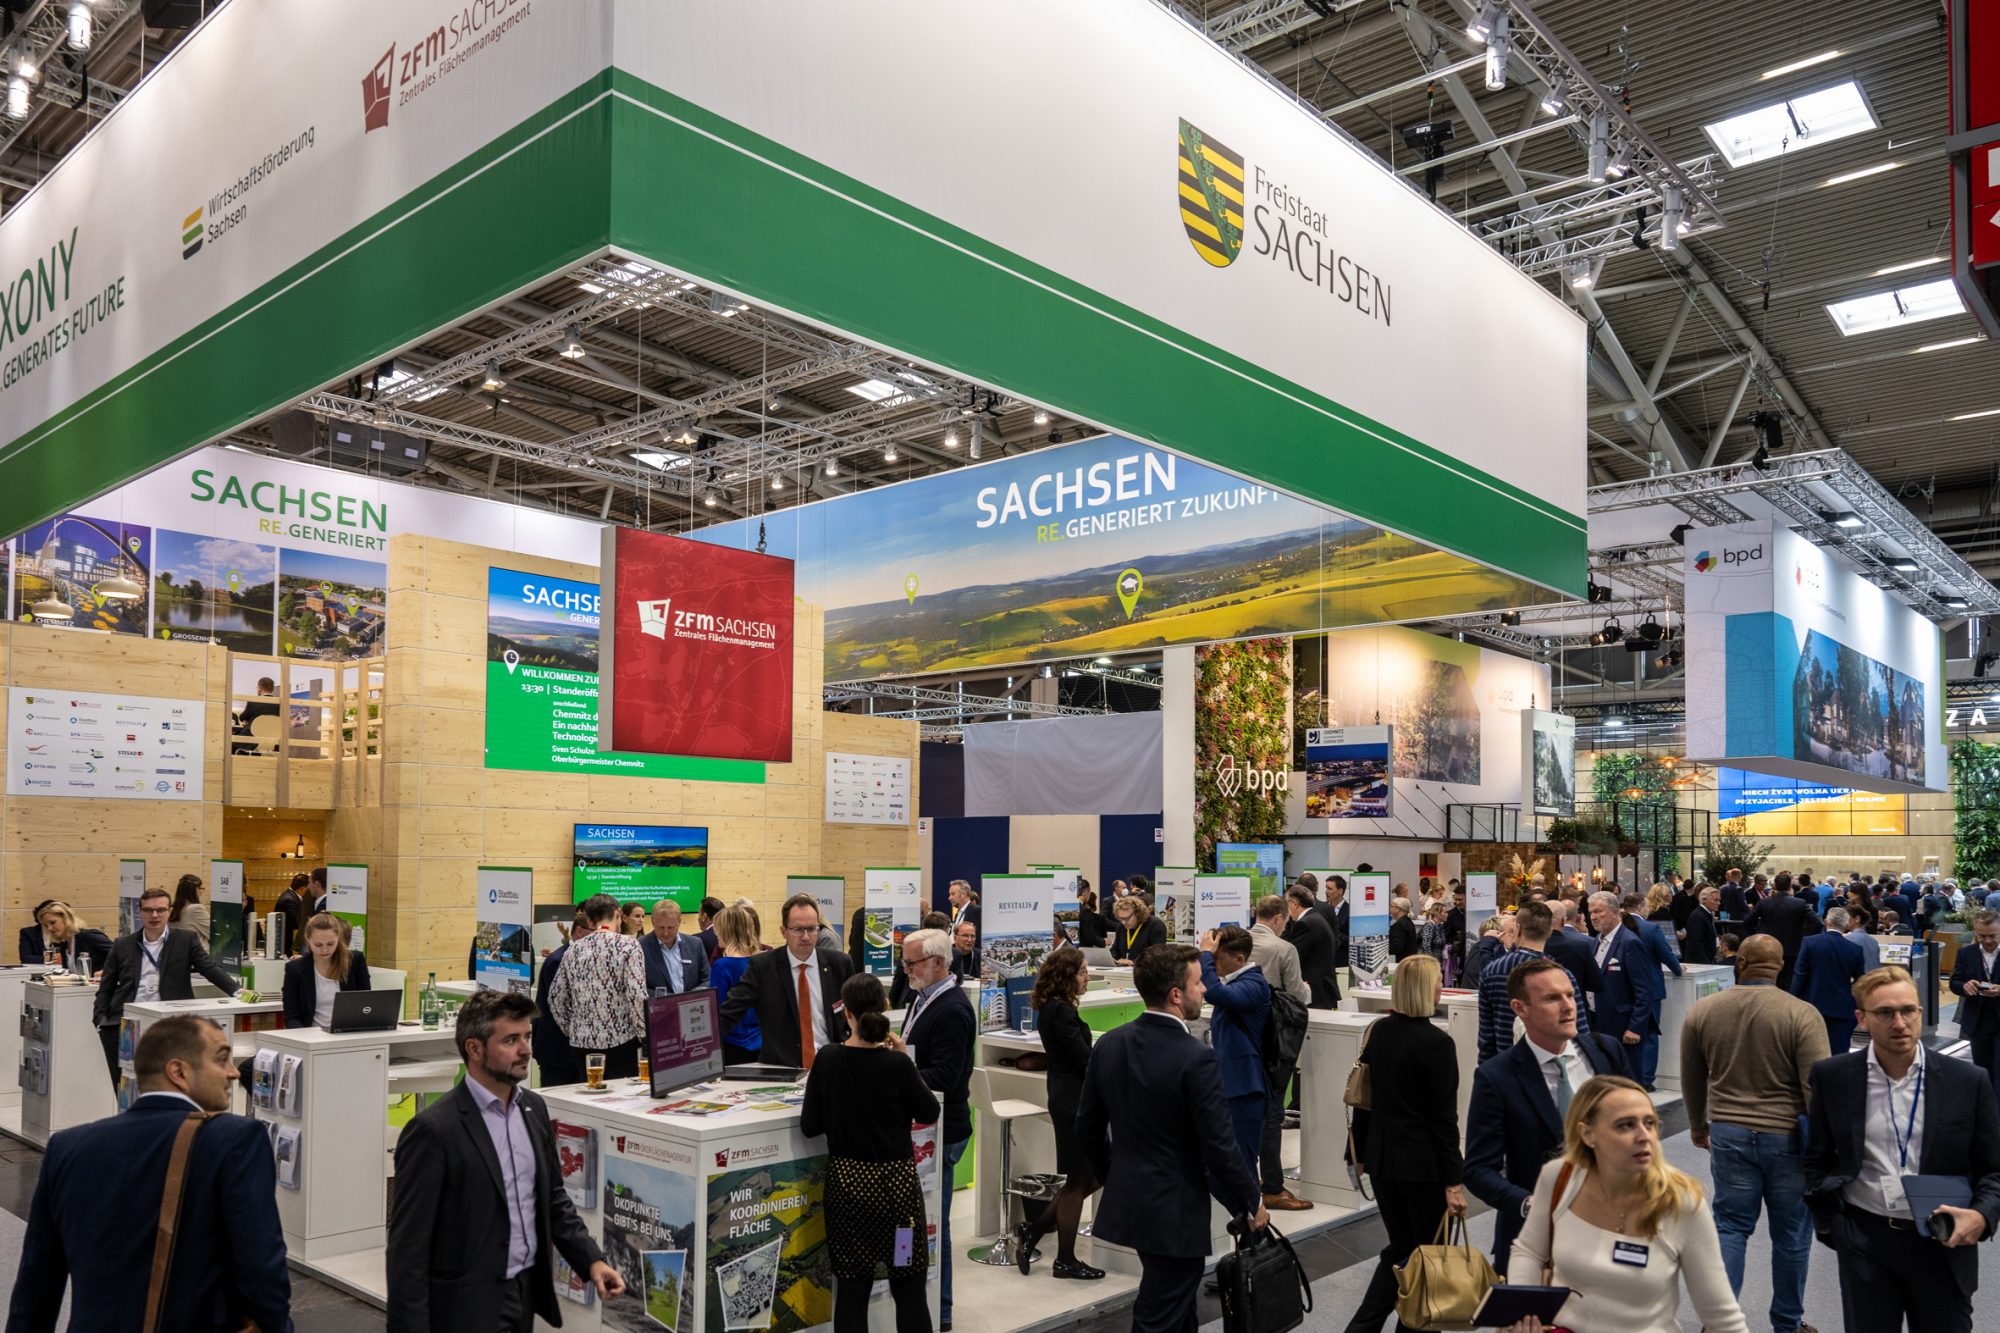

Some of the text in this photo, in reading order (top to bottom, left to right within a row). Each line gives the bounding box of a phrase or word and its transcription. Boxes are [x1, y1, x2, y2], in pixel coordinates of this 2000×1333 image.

[450, 0, 519, 50] SACH
[399, 2, 531, 107] Zentrales Flächenmanagement
[208, 126, 315, 217] Wirtschaftsförderung
[1254, 165, 1328, 238] Freistaat
[208, 204, 247, 243] Sachsen
[1254, 204, 1391, 327] SACHSEN
[73, 276, 125, 341] FUTURE
[191, 469, 387, 532] SACHSEN
[976, 452, 1176, 528] SACHSEN
[1037, 501, 1176, 544] RE.GENERIERT
[259, 518, 387, 551] RE.GENERIERT
[1724, 543, 1763, 566] bpd
[35, 617, 75, 627] CHEMNITZ
[716, 616, 776, 640] SACHSEN
[674, 628, 775, 649] Zentrales Flächenmanagement
[522, 668, 584, 683] WILLKOMMEN
[521, 684, 544, 694] 13:30
[552, 709, 592, 721] Chemnitz
[552, 720, 599, 732] Ein nachhal
[552, 745, 595, 755] Sven Schulze
[552, 755, 645, 768] Oberbürgermeister Chemnitz
[1246, 760, 1288, 798] bpd
[1735, 797, 1796, 806] PRZYJACIELE,
[1771, 787, 1793, 796] ŻYJE
[587, 828, 635, 839] SACHSEN
[821, 898, 834, 906] HEIL
[998, 902, 1032, 910] REVITALIS
[751, 1144, 779, 1157] SACHSEN
[730, 1188, 752, 1203] WIR
[730, 1194, 808, 1221] KOORDINIEREN
[614, 1213, 674, 1243] GIBT'S BEI UNS.
[729, 1218, 771, 1239] FLÄCHE
